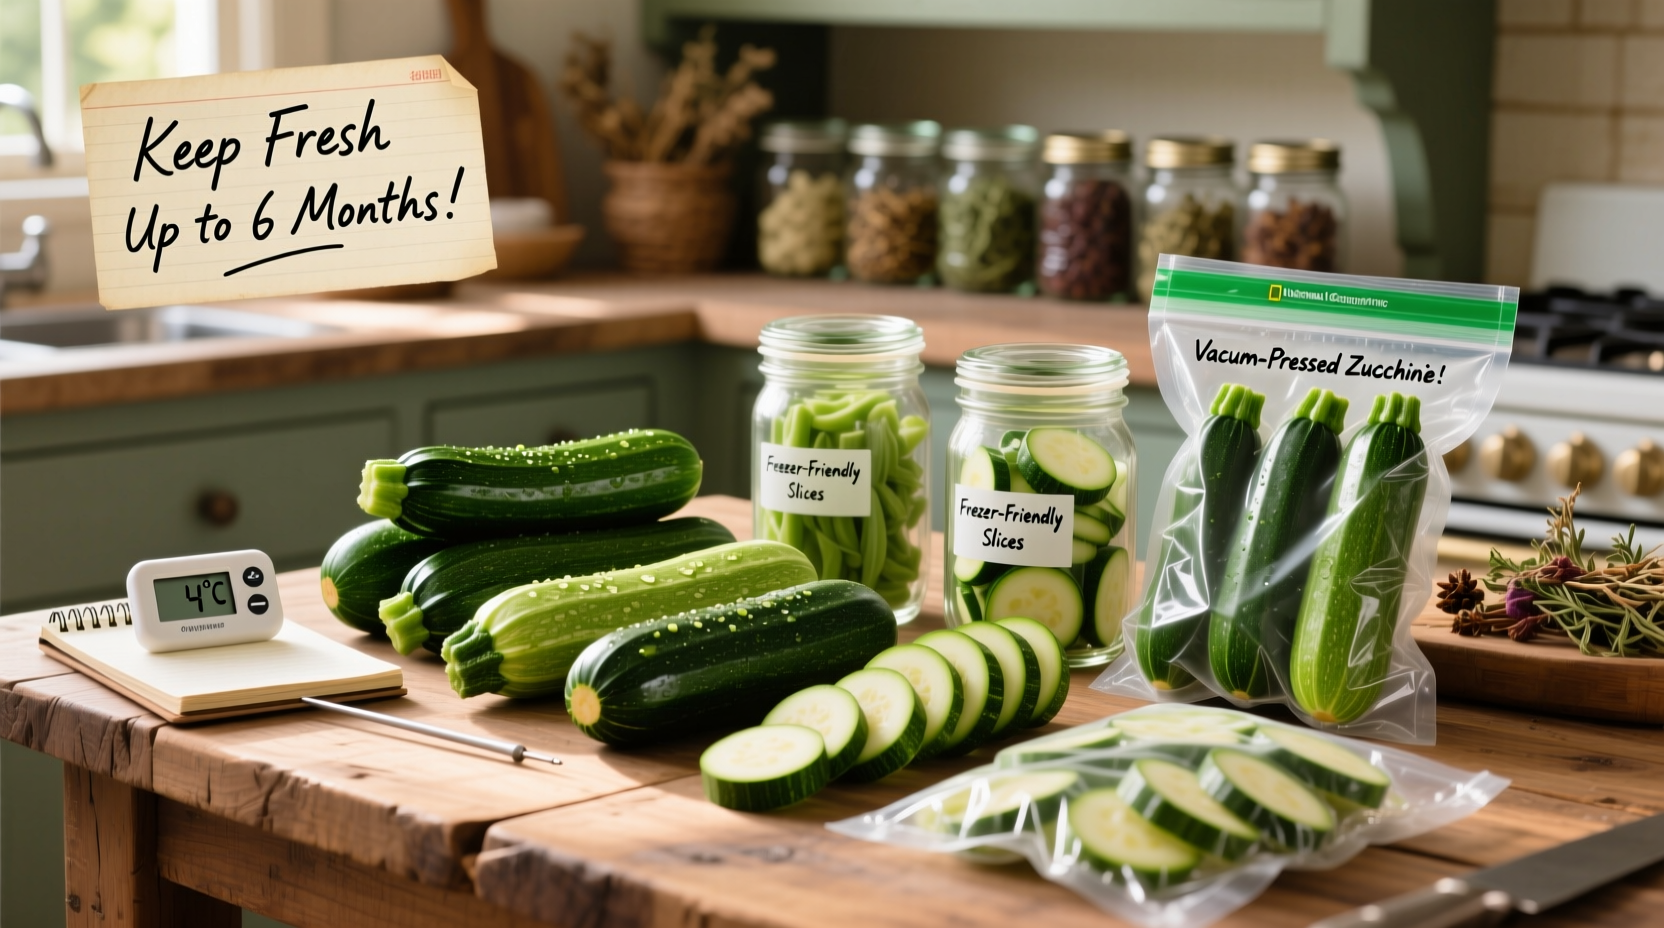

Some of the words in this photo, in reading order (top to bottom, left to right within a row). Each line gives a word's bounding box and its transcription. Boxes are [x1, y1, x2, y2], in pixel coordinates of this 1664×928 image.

[133, 116, 241, 191] Keep
[265, 98, 391, 168] Fresh
[125, 203, 179, 273] Up
[194, 203, 232, 244] to
[252, 190, 275, 241] 6
[290, 166, 465, 236] Months!
[1195, 339, 1343, 375] Vacum-Pressed
[787, 481, 825, 501] Slices
[960, 498, 1064, 534] Frezer-Friendly
[982, 527, 1025, 551] Slices
[184, 579, 227, 613] 4°C
